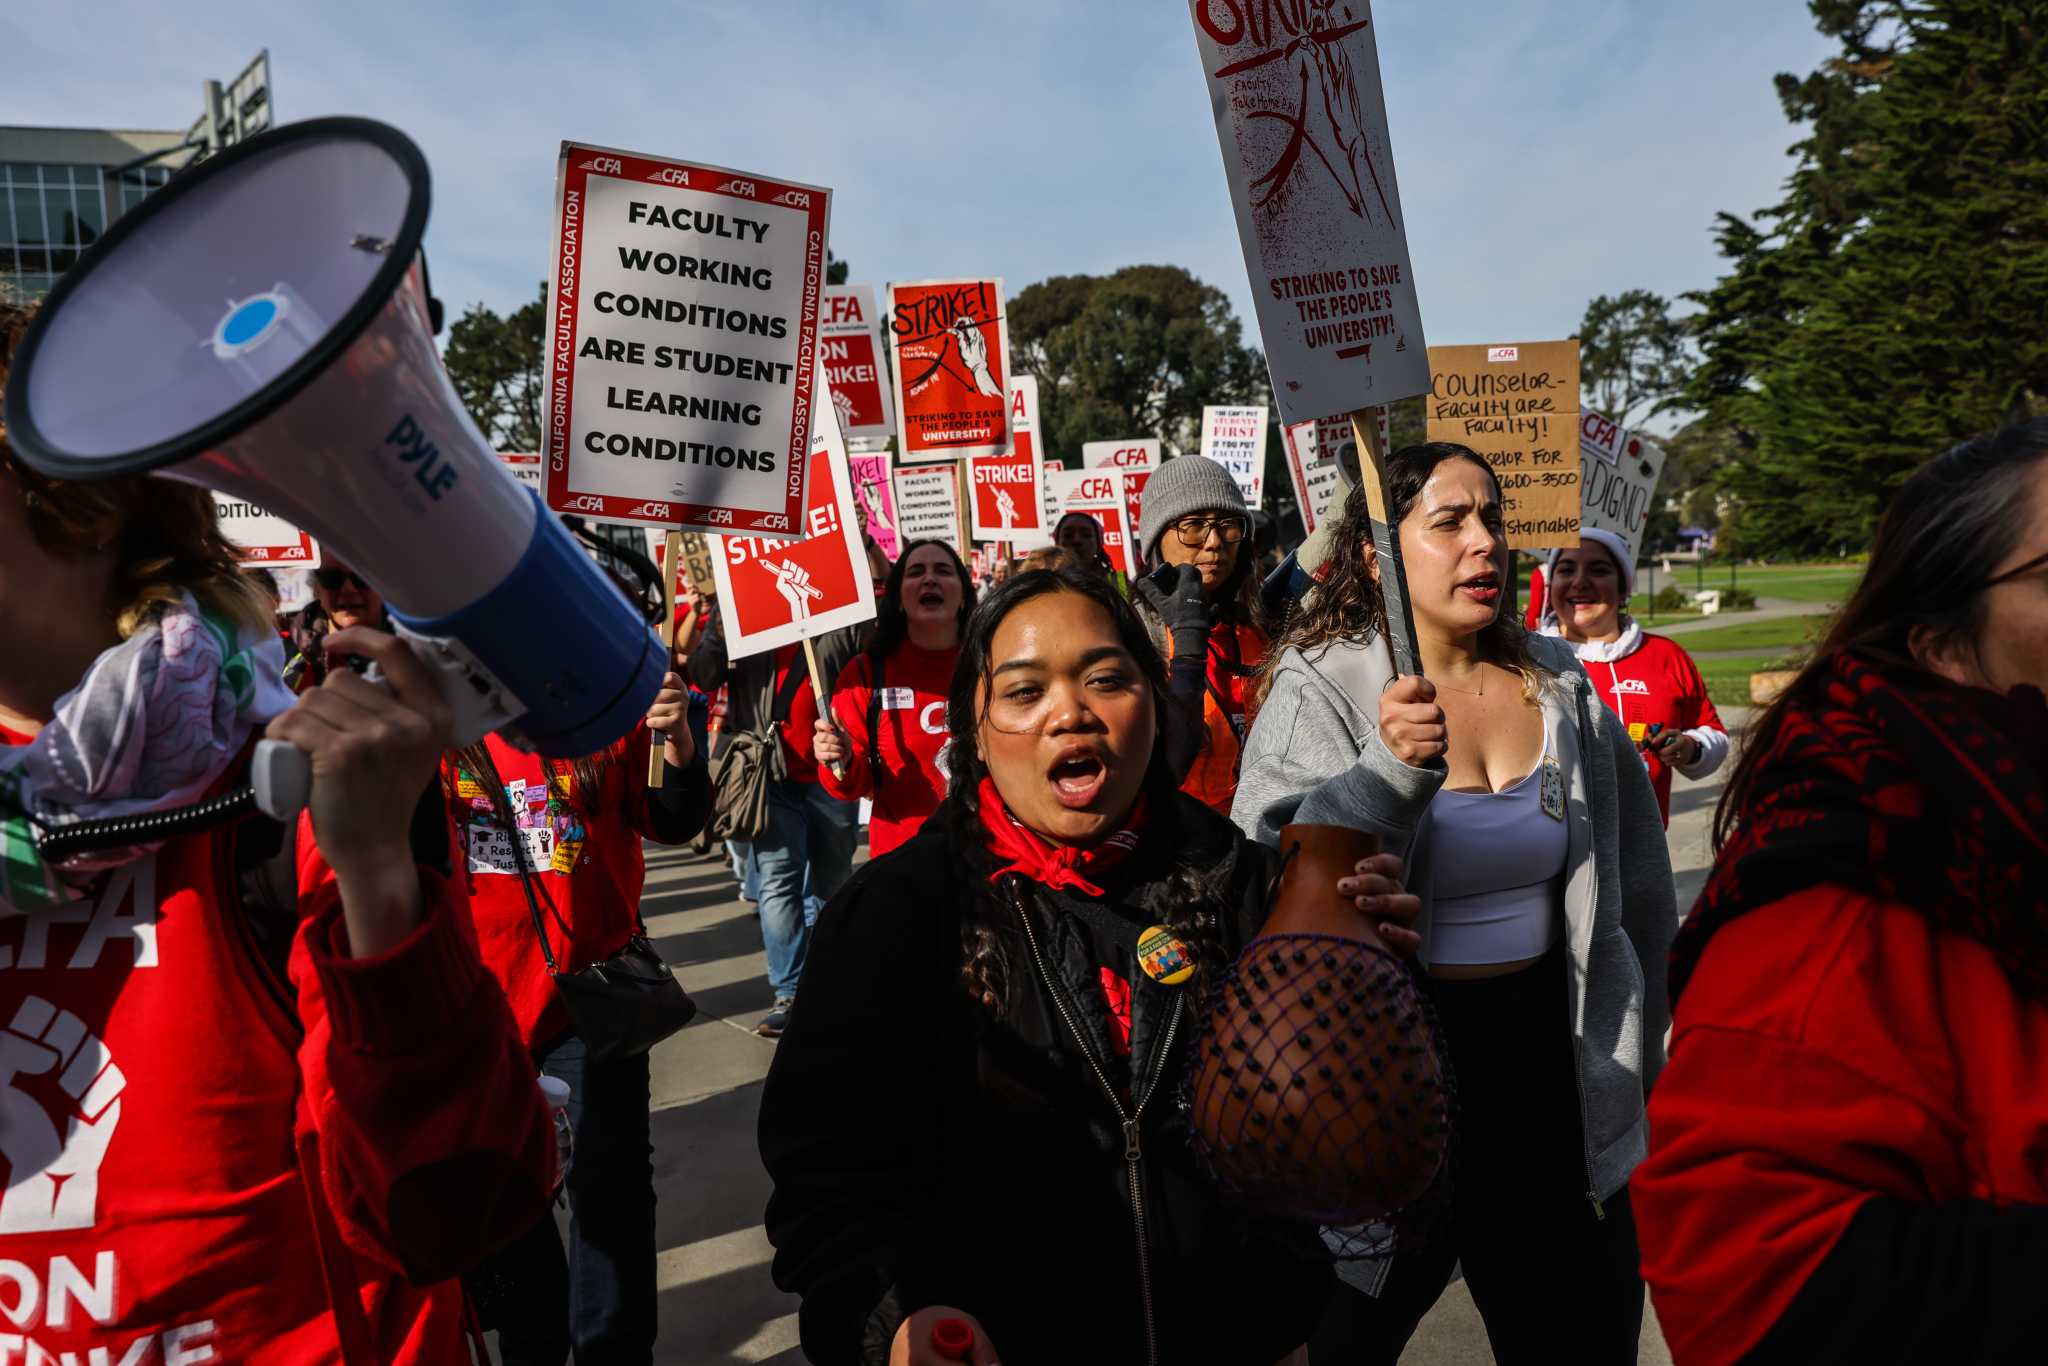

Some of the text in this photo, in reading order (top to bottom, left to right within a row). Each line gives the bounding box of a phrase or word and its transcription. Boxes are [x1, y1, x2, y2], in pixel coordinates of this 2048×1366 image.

[593, 157, 621, 175] CFA
[662, 168, 689, 185] CFA
[730, 180, 756, 198] CFA
[785, 191, 810, 208] CFA
[628, 202, 770, 243] FACULTY
[618, 246, 772, 291] WORKING
[1270, 264, 1400, 300] STRIKING TO SAVE
[594, 291, 787, 338] CONDITIONS
[891, 282, 990, 336] STRIKE!
[1296, 289, 1392, 322] THE PEOPLE'S
[552, 190, 580, 472] CALIFORNIA FACULTY ASSOCIATION
[1304, 314, 1395, 349] UNIVERSITY!
[579, 336, 793, 385] ARE STUDENT
[1498, 349, 1514, 358] CFA
[789, 231, 820, 498] CALIFORNIA FACULTY ASSOCIATION
[607, 386, 762, 426] LEARNING
[905, 409, 1004, 424] STRIKING TO SAVE
[920, 423, 938, 431] THE
[922, 428, 991, 441] UNIVERSITY!
[1213, 426, 1255, 437] FIRST
[1583, 413, 1617, 450] CFA
[584, 431, 776, 473] CONDITIONS
[1222, 440, 1238, 448] YOU
[1240, 441, 1255, 449] PUT
[1114, 447, 1148, 466] CFA
[1533, 449, 1563, 465] FOR
[904, 478, 941, 486] FACULTY
[975, 464, 1033, 484] STRIKE!
[904, 489, 945, 498] WORKING
[1081, 478, 1113, 499] CFA
[1585, 459, 1648, 533] DIGNO
[576, 495, 604, 512] CFA
[643, 502, 670, 519] CFA
[900, 500, 951, 510] CONDITIONS
[708, 509, 733, 525] CFA
[763, 514, 789, 530] CFA
[918, 511, 955, 520] STUDENT
[909, 524, 949, 533] LEARNING
[288, 547, 306, 558] CFA
[1623, 680, 1648, 692] CFA
[0, 850, 159, 970] FA
[0, 1250, 117, 1328] ON
